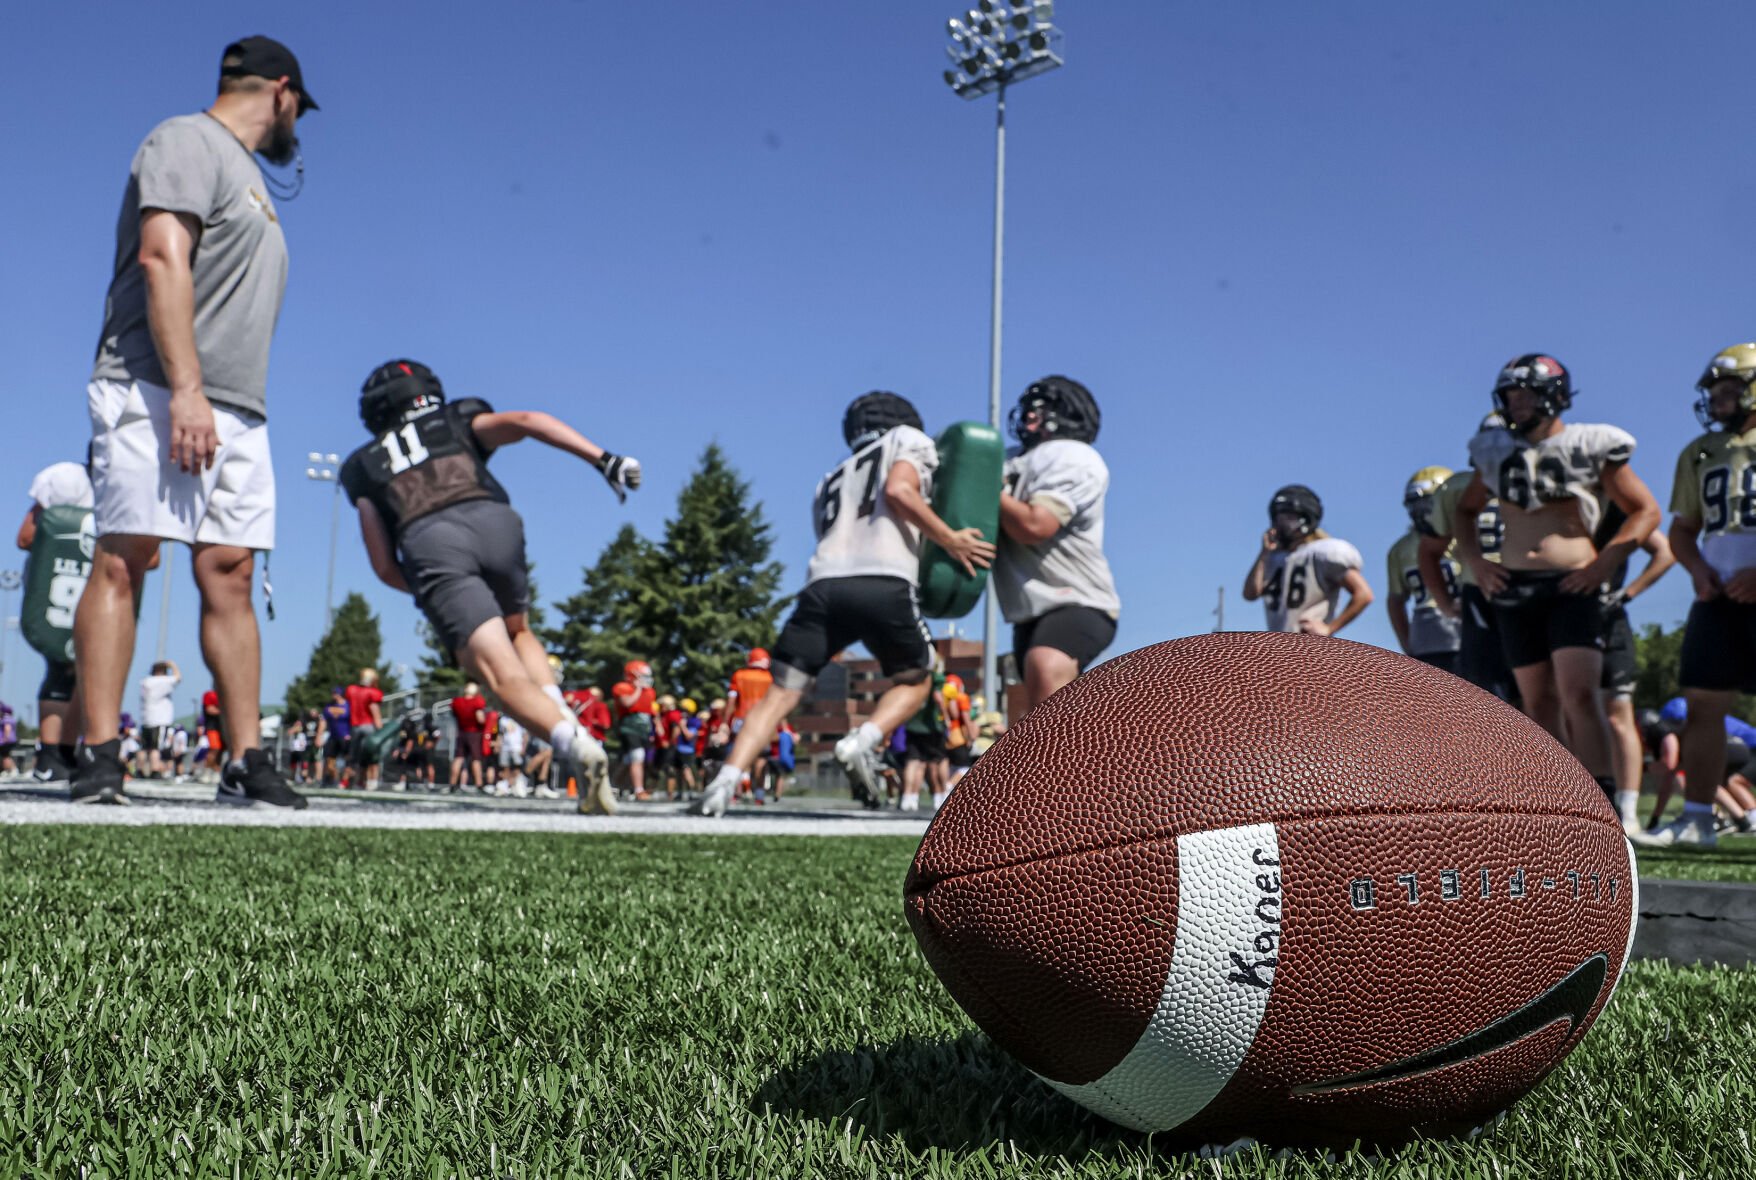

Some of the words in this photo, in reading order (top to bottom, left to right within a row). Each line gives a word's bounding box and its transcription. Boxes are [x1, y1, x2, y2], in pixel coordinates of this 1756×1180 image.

[381, 419, 430, 475] 11
[1262, 565, 1307, 612] 46
[1349, 868, 1618, 911] ALL-FIELD
